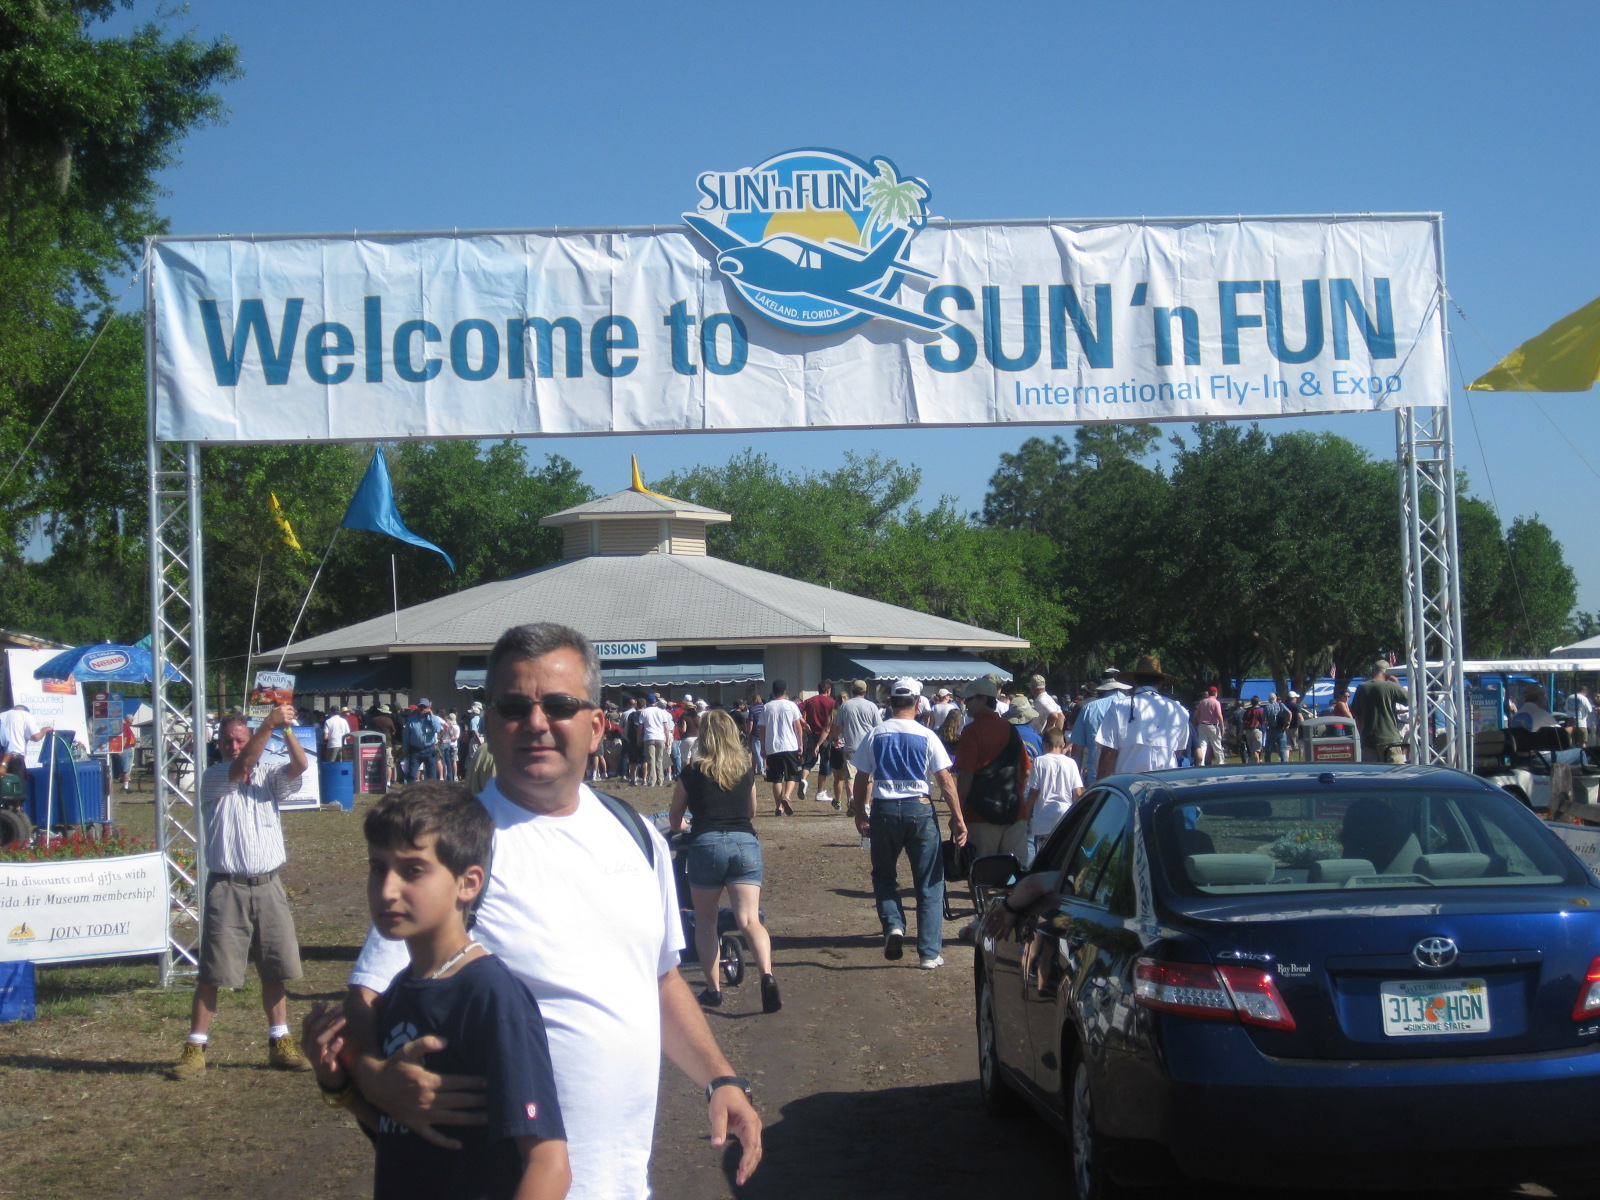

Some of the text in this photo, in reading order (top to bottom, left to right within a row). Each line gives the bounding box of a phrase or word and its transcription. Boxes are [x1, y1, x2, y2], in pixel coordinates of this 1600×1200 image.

[755, 291, 840, 320] LAKELAND, FLORIDA
[198, 295, 640, 387] Welcome
[663, 298, 749, 377] to
[922, 282, 1114, 374] SUN
[1218, 277, 1397, 365] FUN
[1015, 369, 1403, 406] International Fly-In & Expo
[20, 693, 64, 704] Discounted
[29, 705, 64, 716] dmission!
[1574, 842, 1596, 854] with
[22, 875, 70, 887] discounts
[74, 872, 94, 884] and
[98, 870, 122, 886] gifts
[125, 868, 146, 880] with
[23, 894, 40, 906] Air
[44, 893, 90, 906] Museum
[92, 886, 156, 904] membership!
[50, 921, 131, 943] JOIN TODAY!
[1277, 963, 1291, 977] Ray
[1291, 963, 1312, 973] Brand
[1388, 994, 1484, 1023] 313 HGN
[1406, 1021, 1466, 1032] SUNSHINE STATE
